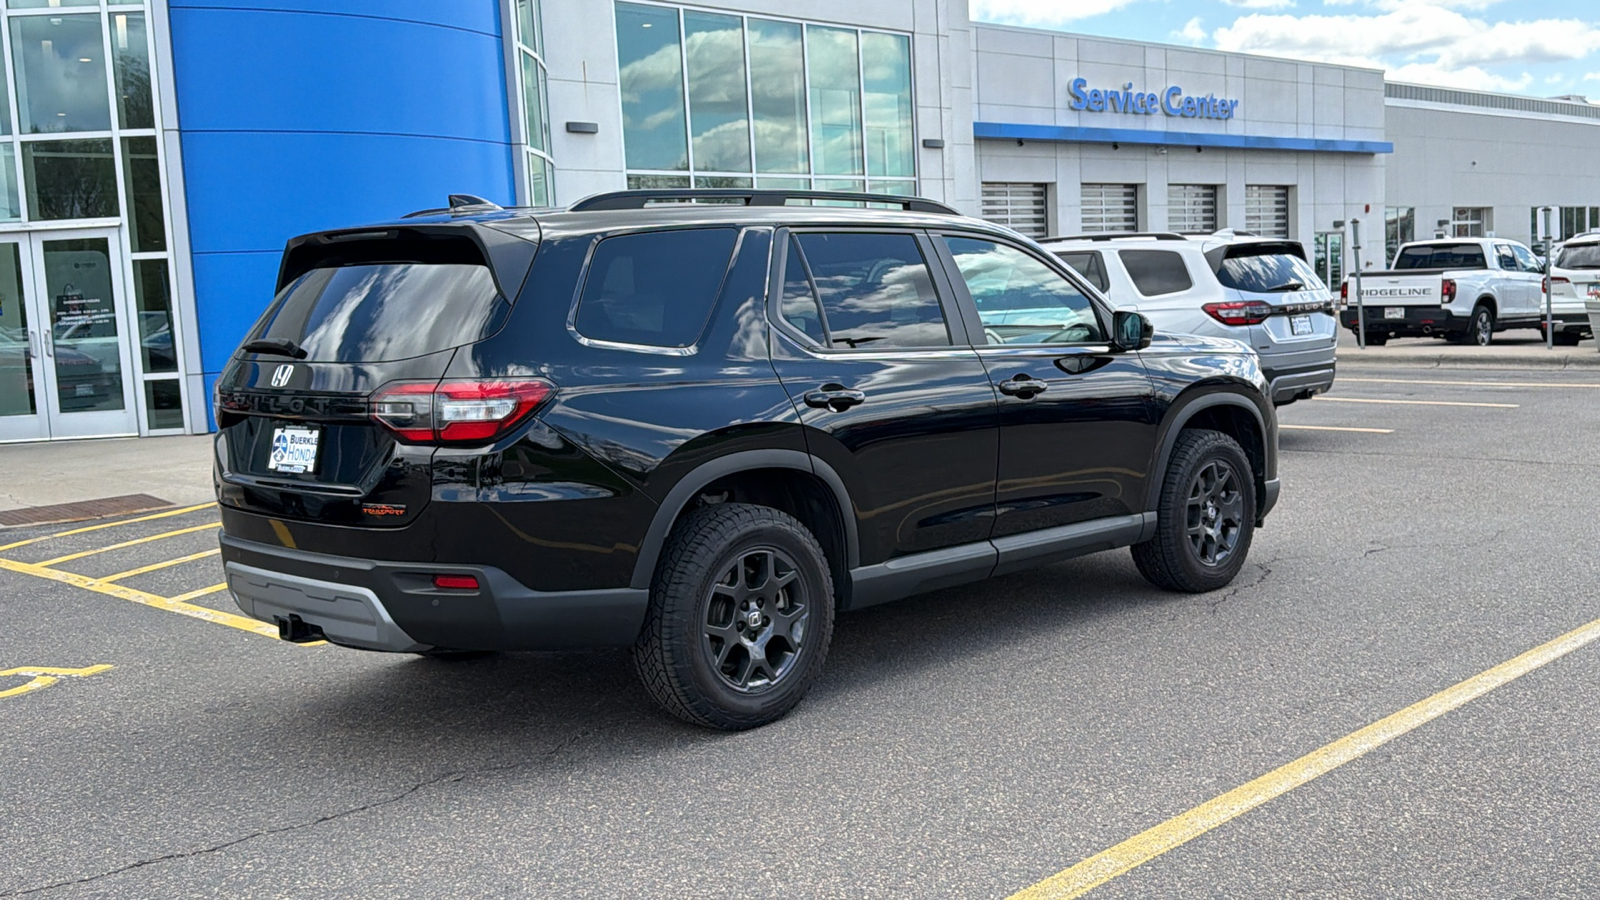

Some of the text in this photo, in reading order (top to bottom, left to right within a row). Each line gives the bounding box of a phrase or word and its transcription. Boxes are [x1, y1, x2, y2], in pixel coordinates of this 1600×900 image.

[1068, 77, 1239, 119] Service Center
[290, 434, 318, 446] BUERKLE
[287, 445, 316, 461] HONDA
